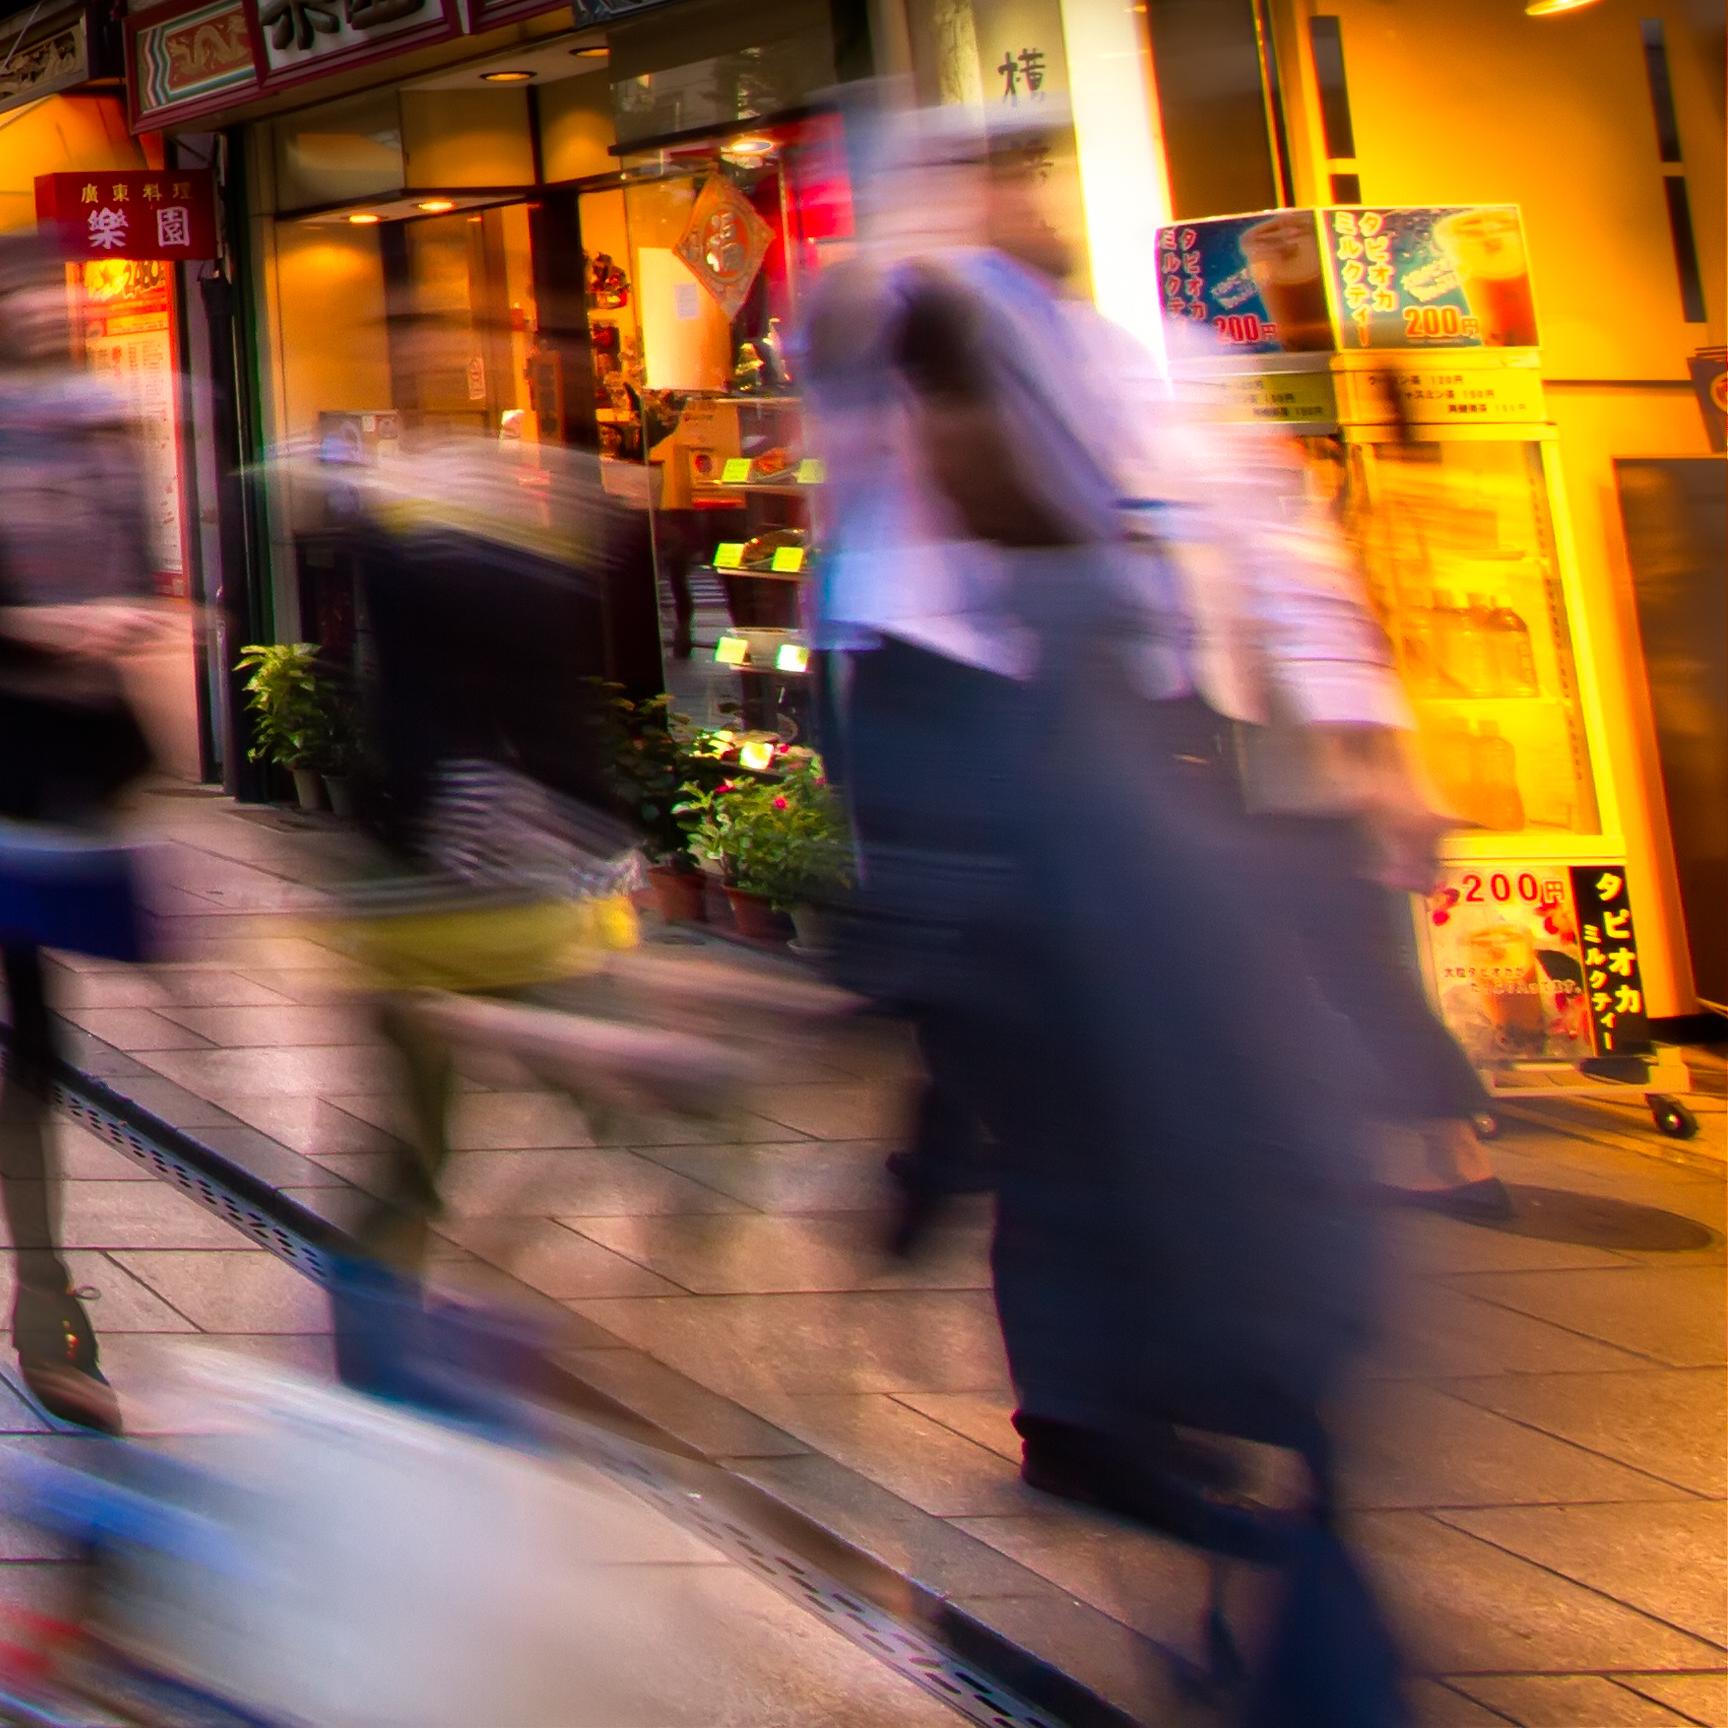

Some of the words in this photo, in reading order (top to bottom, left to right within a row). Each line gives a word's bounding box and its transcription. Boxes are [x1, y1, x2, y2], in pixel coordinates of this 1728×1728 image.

[1360, 211, 1399, 312] タピオカ
[1403, 306, 1479, 338] 200円
[1462, 872, 1565, 904] 200円
[1583, 923, 1617, 1051] ミルクティー
[1595, 872, 1643, 1014] タピオカ
